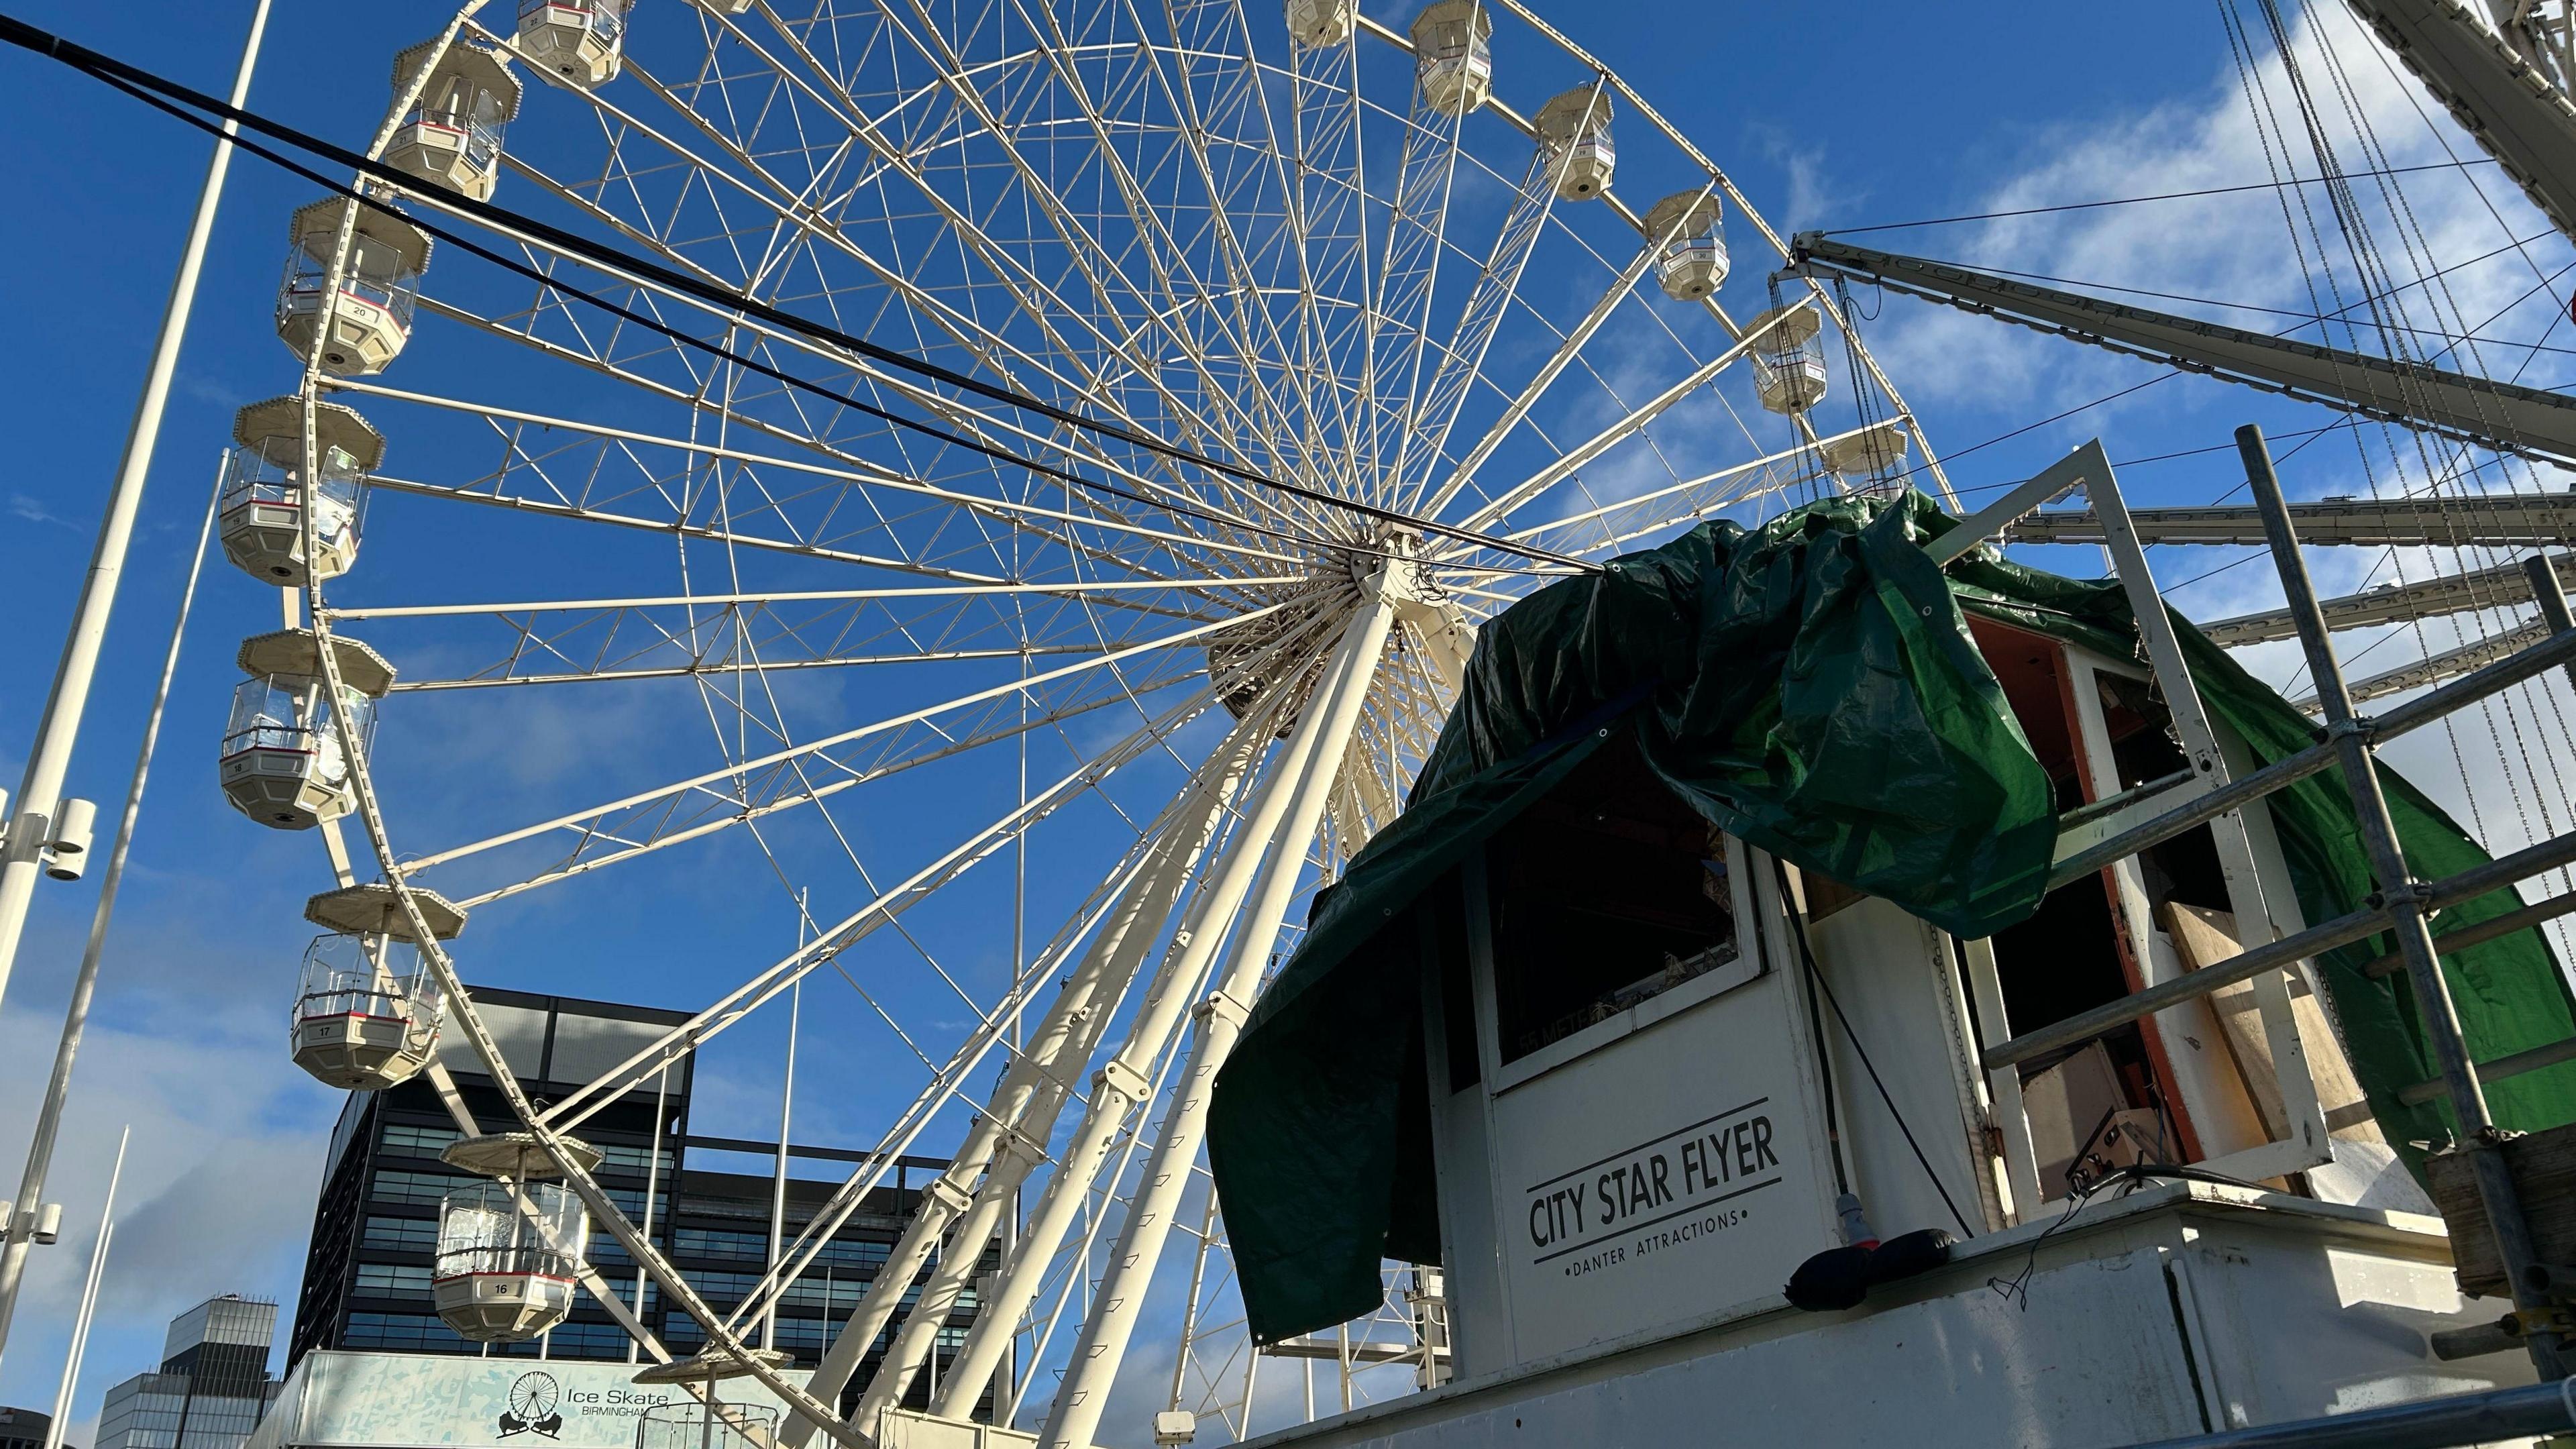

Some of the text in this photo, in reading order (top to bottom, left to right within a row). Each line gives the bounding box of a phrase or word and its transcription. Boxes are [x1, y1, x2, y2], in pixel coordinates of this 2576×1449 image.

[354, 307, 366, 317] 20
[233, 517, 241, 527] 19
[319, 1026, 330, 1036] 17
[1529, 1116, 1780, 1248] CITY STAR FLYER
[1573, 1210, 1738, 1277] DANTER ATTRACTIONS
[494, 1284, 507, 1294] 16
[568, 1389, 669, 1405] Ice Skate
